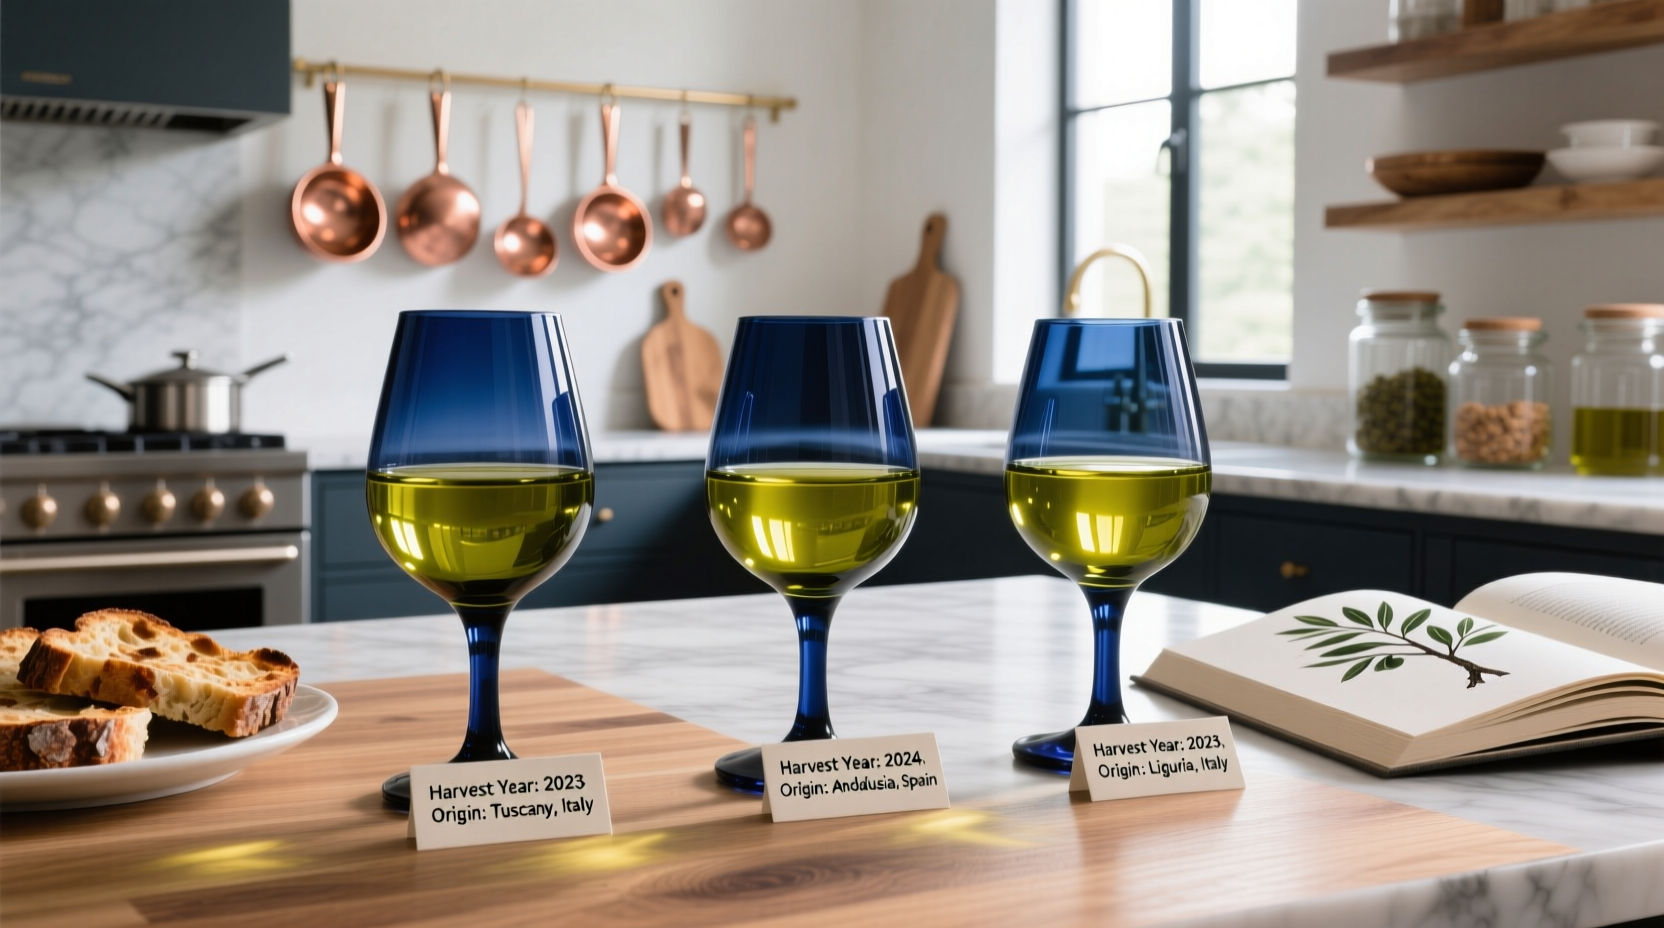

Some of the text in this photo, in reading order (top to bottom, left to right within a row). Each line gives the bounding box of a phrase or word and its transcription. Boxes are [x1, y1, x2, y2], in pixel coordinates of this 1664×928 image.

[1093, 741, 1147, 757] Harvest
[1149, 738, 1185, 752] Year:
[780, 757, 839, 775] Harvest
[841, 756, 881, 771] Year:
[1098, 755, 1229, 780] Origin: Liguria, Italy
[429, 774, 586, 800] Harvest Year: 2023
[780, 782, 830, 799] Origin:
[902, 772, 938, 791] Spain
[431, 796, 594, 825] Origin: Tuscany, Italy
